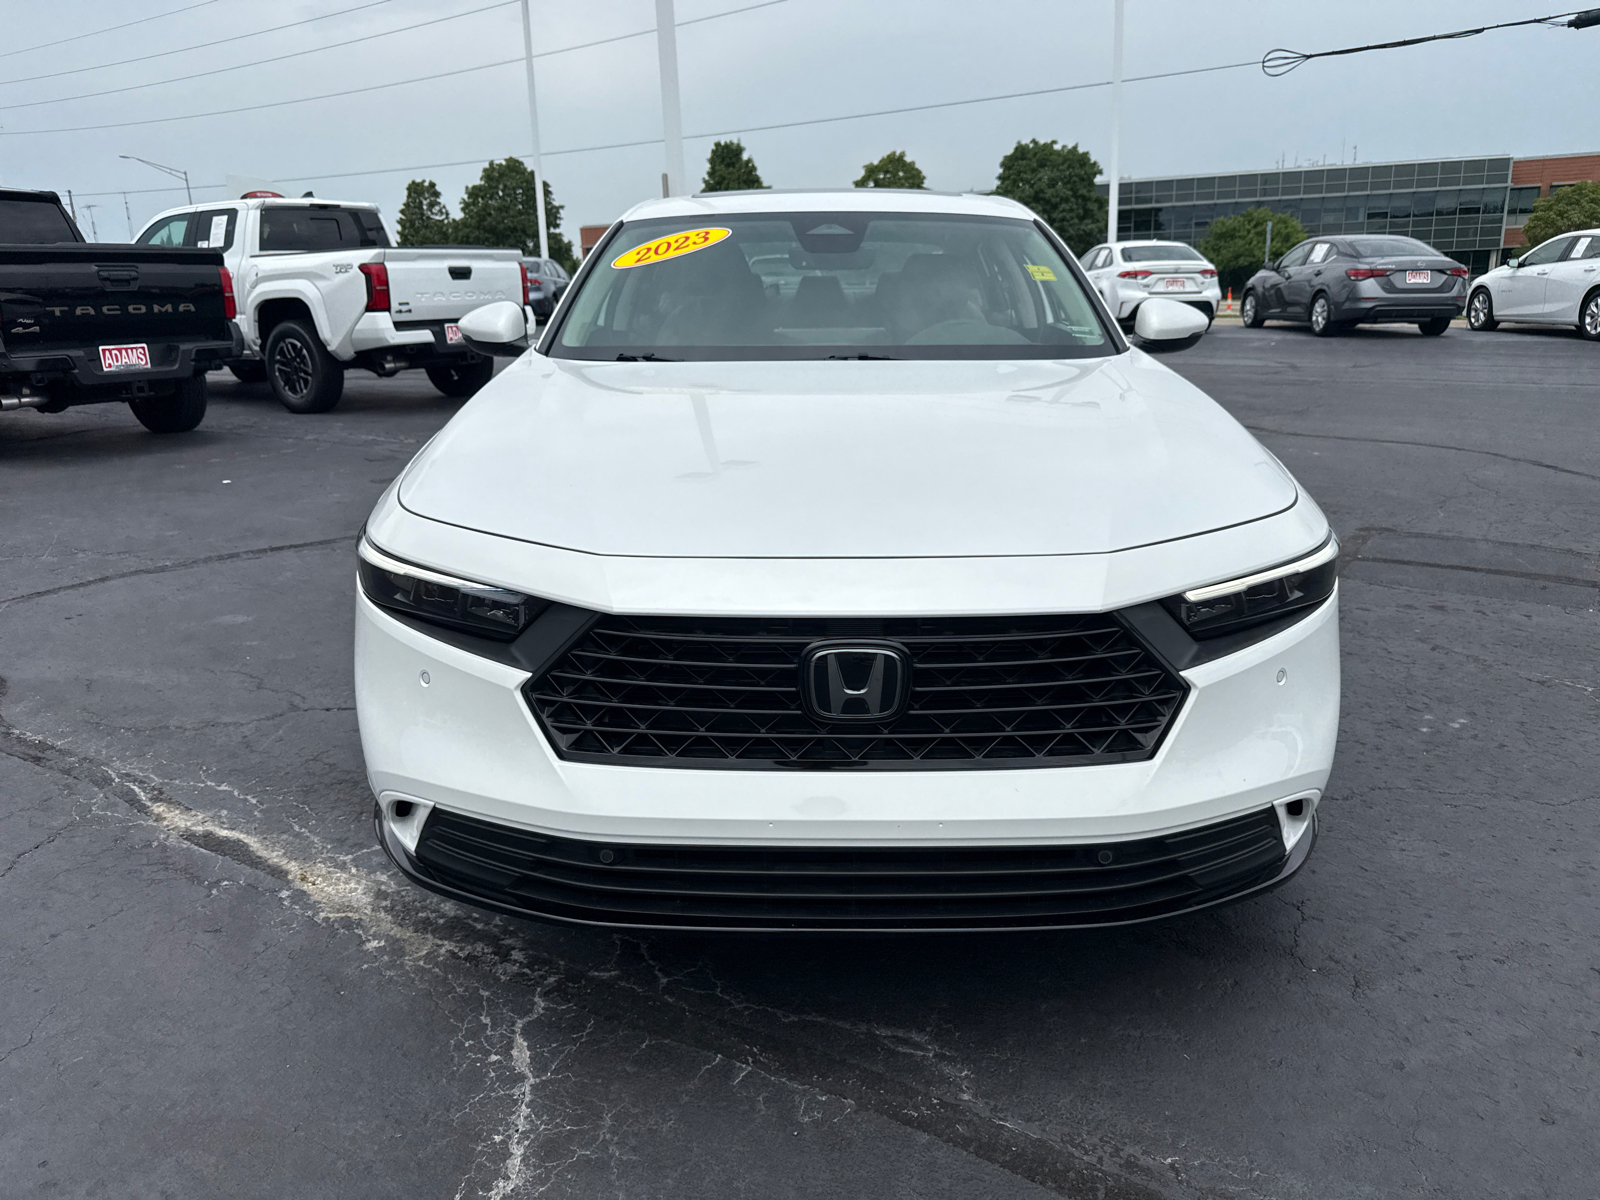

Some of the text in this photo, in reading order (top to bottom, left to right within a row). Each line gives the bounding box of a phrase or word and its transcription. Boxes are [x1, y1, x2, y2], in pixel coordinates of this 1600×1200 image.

[634, 231, 710, 264] 2023
[415, 291, 506, 302] TACOMA
[45, 303, 196, 317] TACOMA
[104, 348, 146, 367] ADAMS
